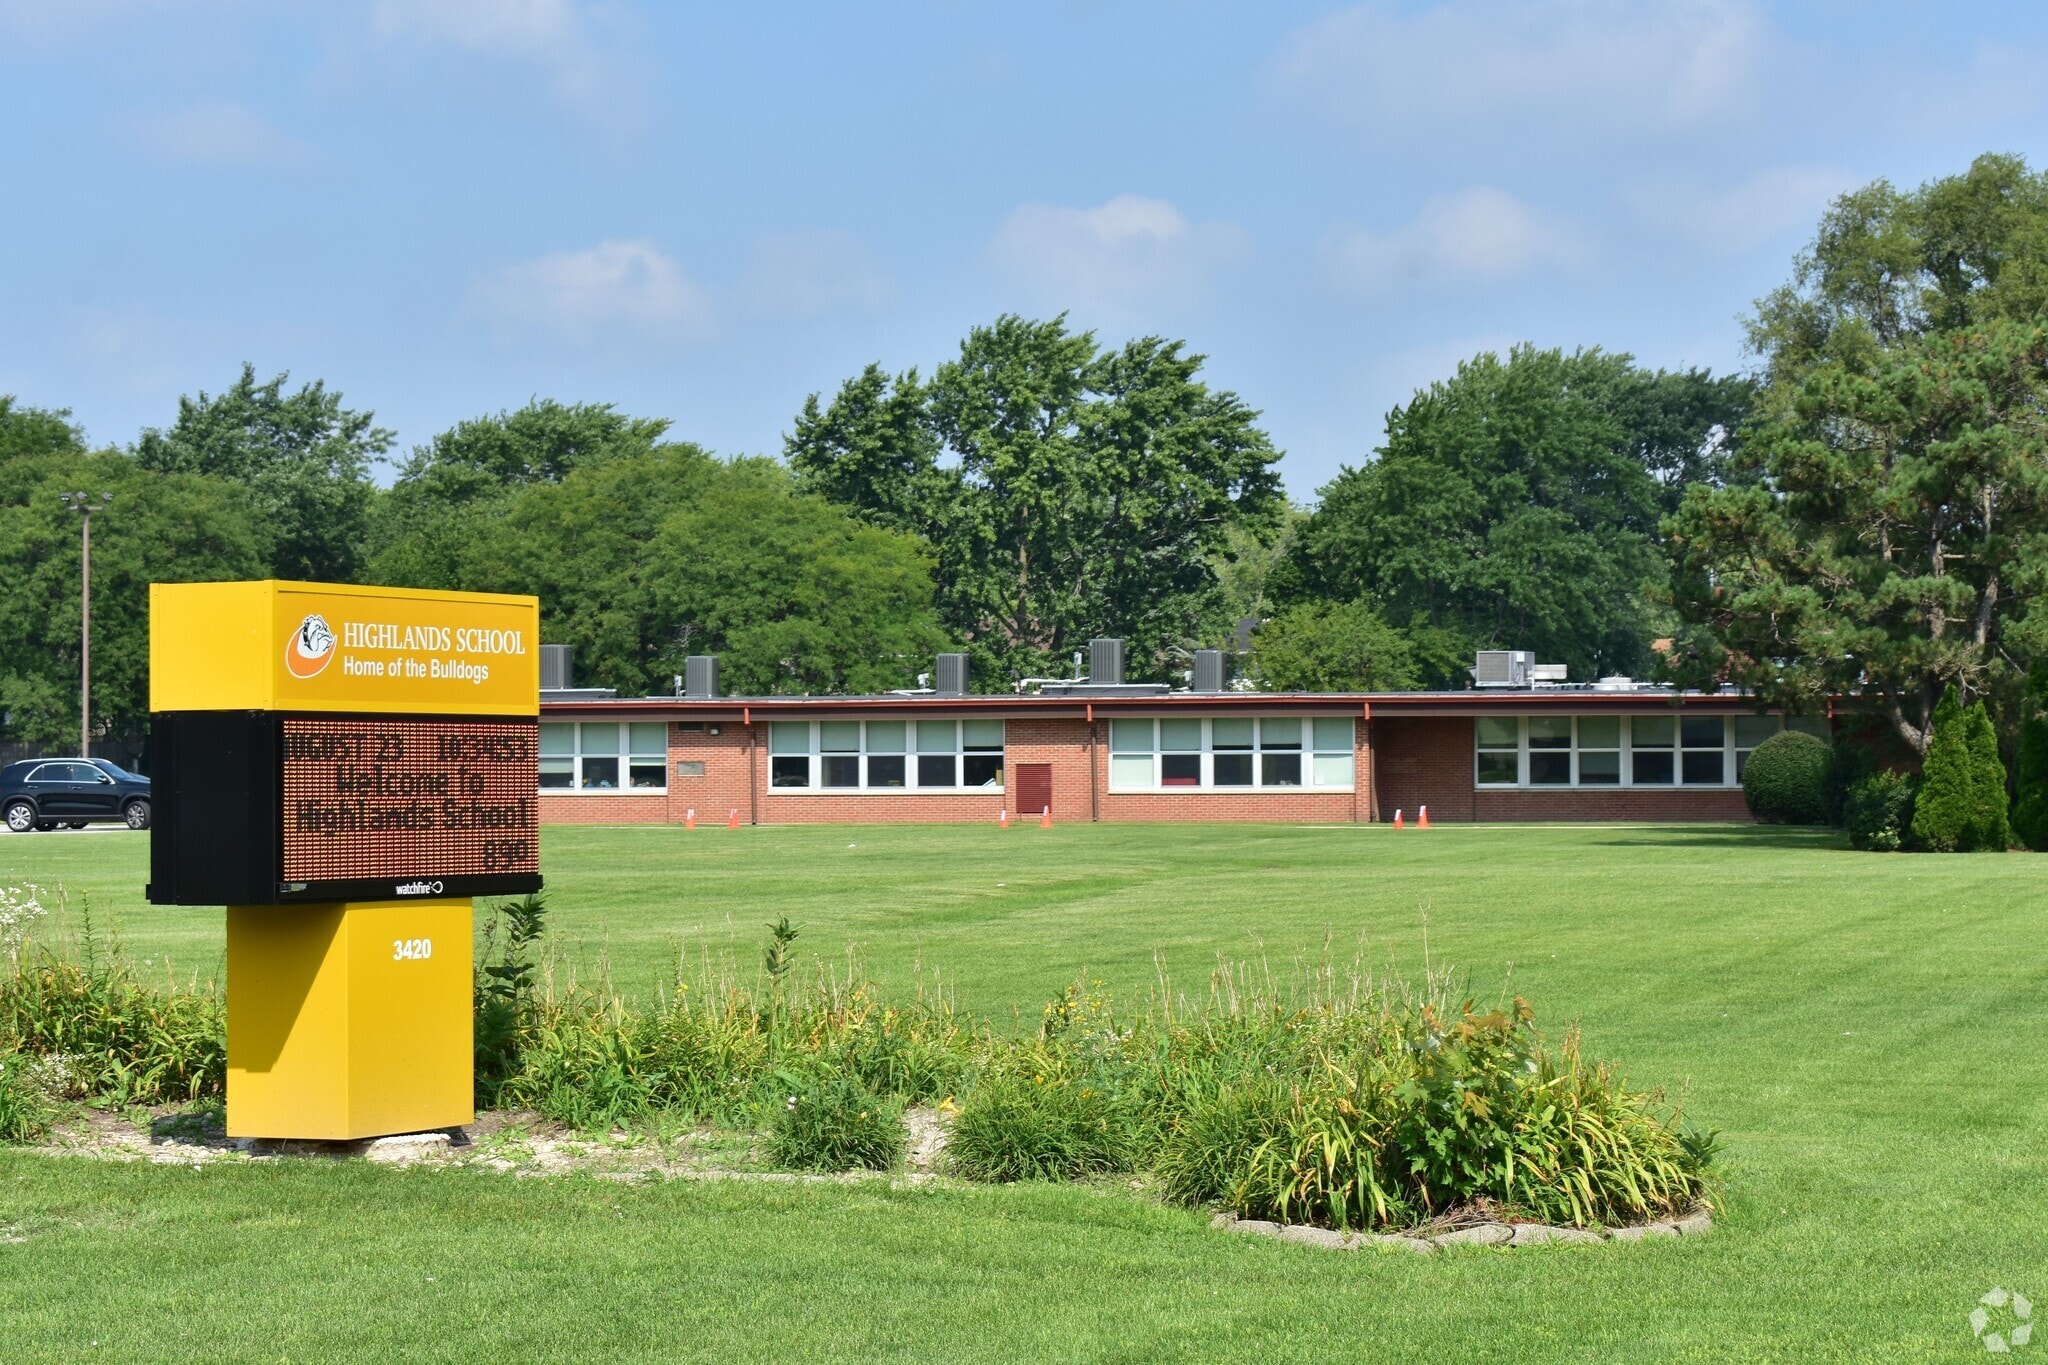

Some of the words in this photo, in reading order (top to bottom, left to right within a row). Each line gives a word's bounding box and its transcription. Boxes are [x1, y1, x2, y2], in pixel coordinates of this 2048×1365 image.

[343, 622, 451, 652] HIGHLANDS
[456, 627, 526, 655] SCHOOL
[343, 655, 385, 676] Home
[388, 657, 403, 677] of
[405, 658, 427, 678] the
[430, 658, 489, 685] Bulldogs
[376, 733, 404, 761] 23
[336, 764, 449, 796] Welcome
[458, 766, 484, 796] to
[296, 799, 434, 836] Highlands
[442, 797, 528, 830] School
[396, 881, 431, 895] watchfire
[393, 938, 432, 961] 3420
